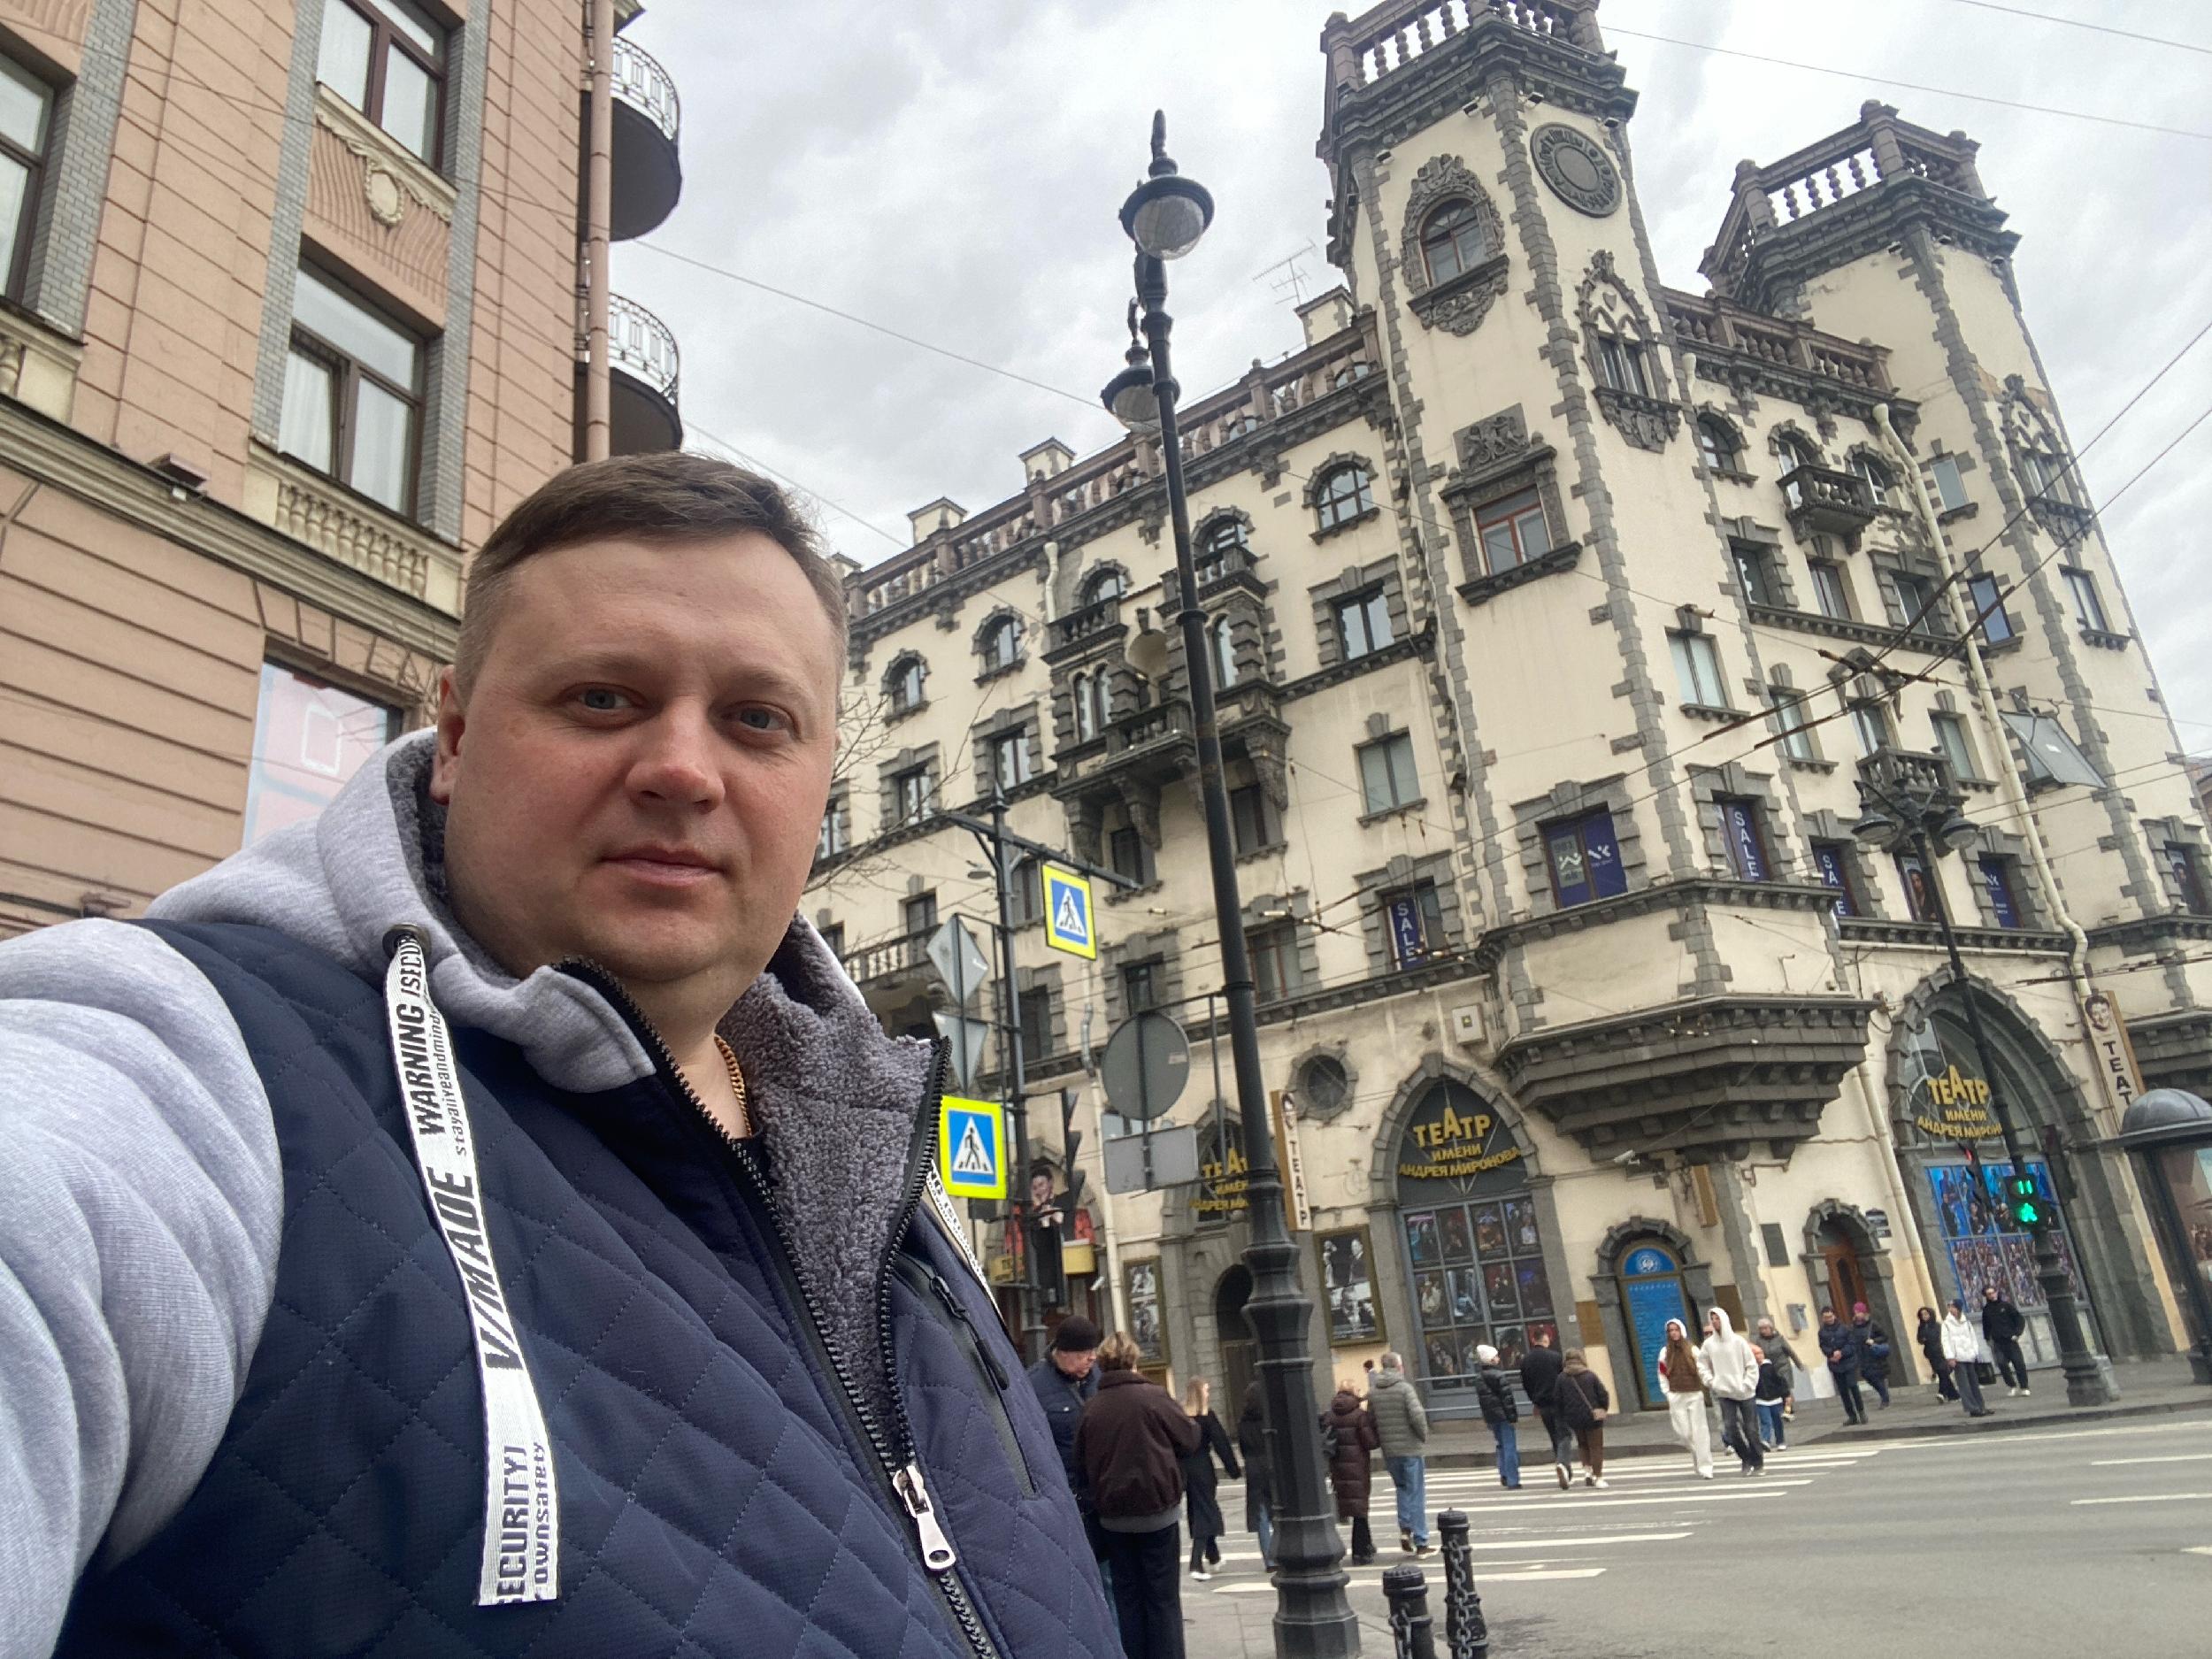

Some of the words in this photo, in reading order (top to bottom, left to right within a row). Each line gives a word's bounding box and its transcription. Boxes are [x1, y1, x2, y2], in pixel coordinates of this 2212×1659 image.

[1734, 811, 1759, 877] SALE
[1823, 855, 1847, 915] SAE
[1398, 902, 1417, 963] SALE
[396, 1002, 446, 1136] WARNING
[1927, 1064, 1990, 1105] ТЕАТР
[2102, 1040, 2131, 1105] ТЕАТ
[1413, 1107, 1491, 1148] ТЕАТР
[1918, 1116, 1963, 1138] АНДРЕЯ
[1963, 1122, 2002, 1139] МИРОН
[1946, 1110, 1987, 1122] ИМЕНИ
[1202, 1147, 1248, 1178] ТЕАТ
[1399, 1164, 1448, 1179] АНДРЕЯ
[1450, 1146, 1522, 1176] МИРОНОВА
[1432, 1143, 1482, 1162] ИМЕНИ
[1289, 1140, 1307, 1226] ТЕАТР
